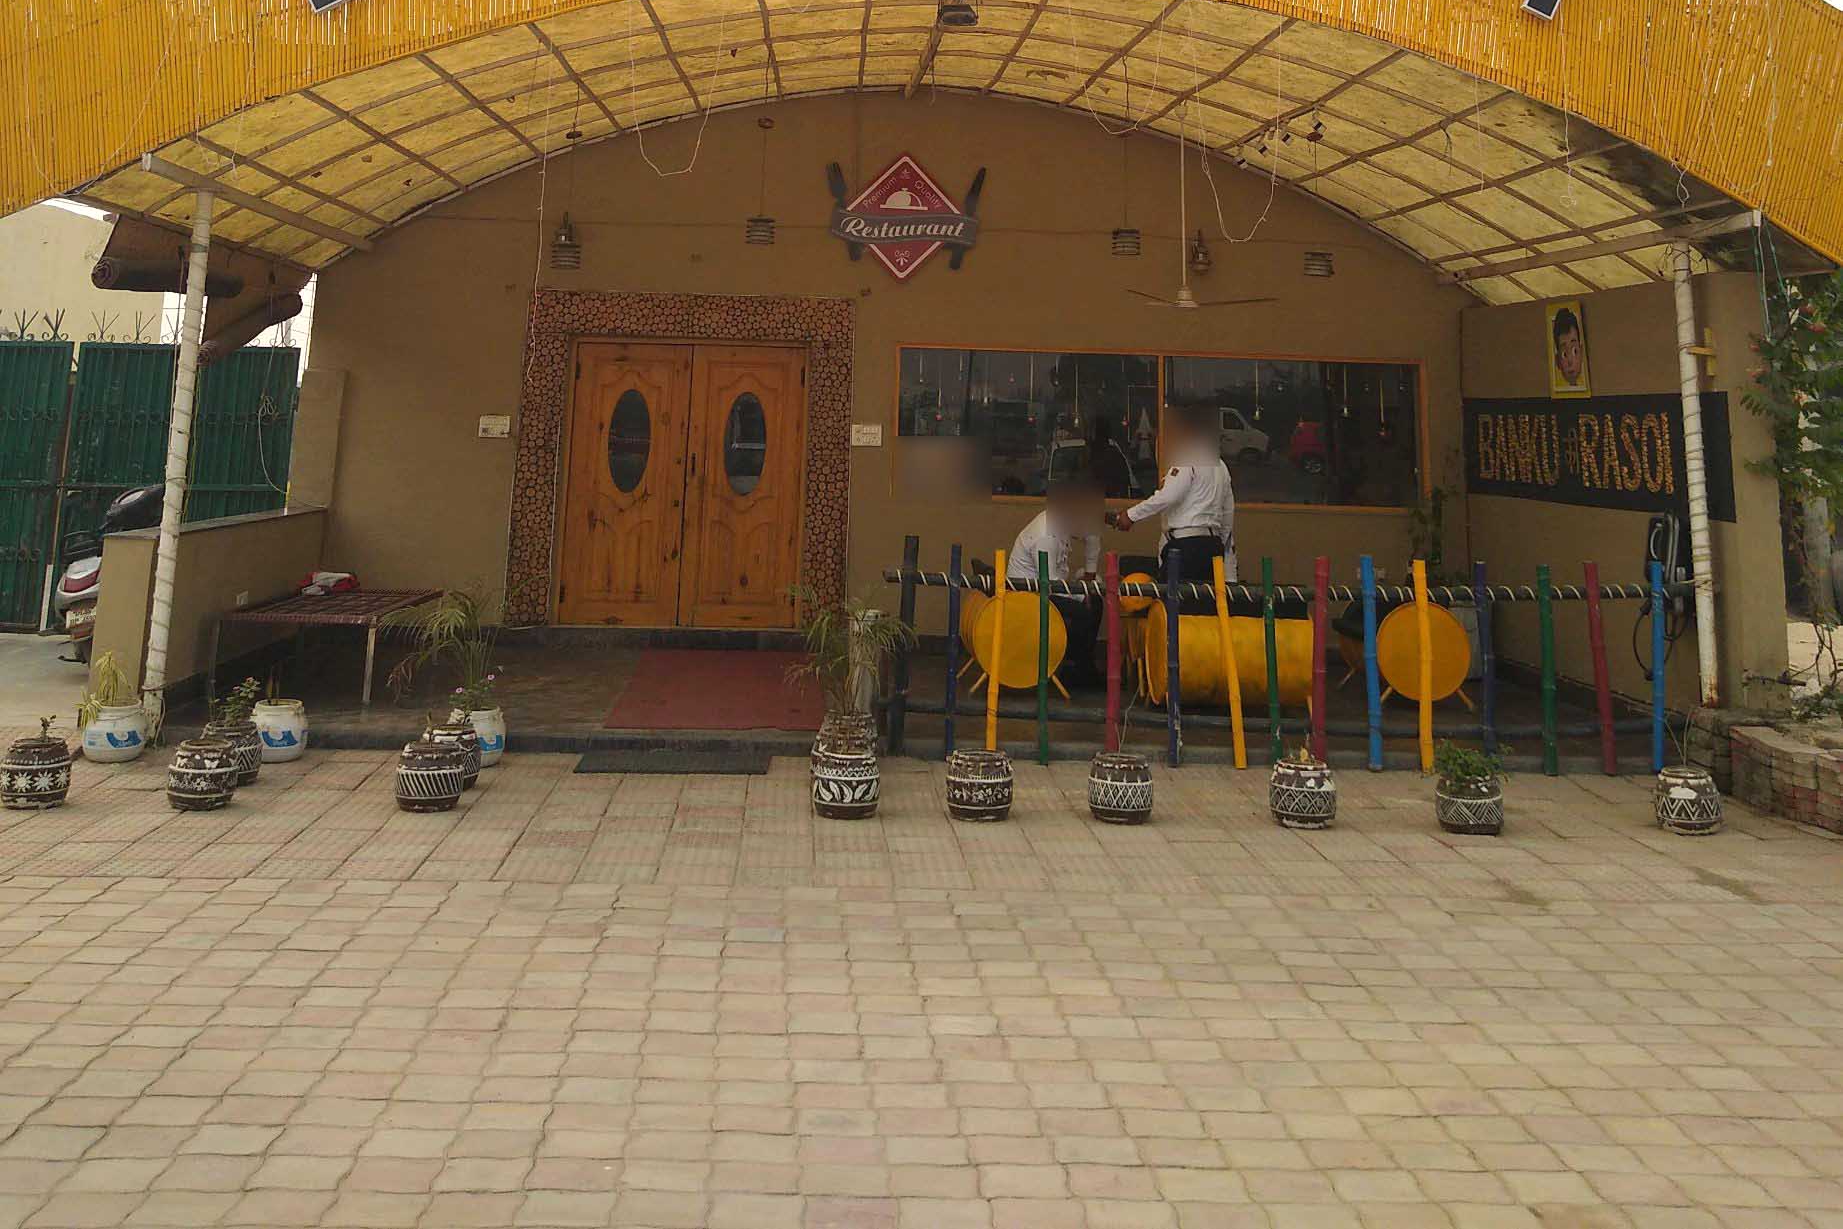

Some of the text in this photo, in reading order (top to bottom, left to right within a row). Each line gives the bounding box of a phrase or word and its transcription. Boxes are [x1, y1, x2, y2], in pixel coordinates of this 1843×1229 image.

[862, 177, 943, 208] Premium Quality
[840, 216, 965, 238] Restaurant
[1478, 413, 1560, 486] BANKU
[1578, 412, 1675, 494] RASOI
